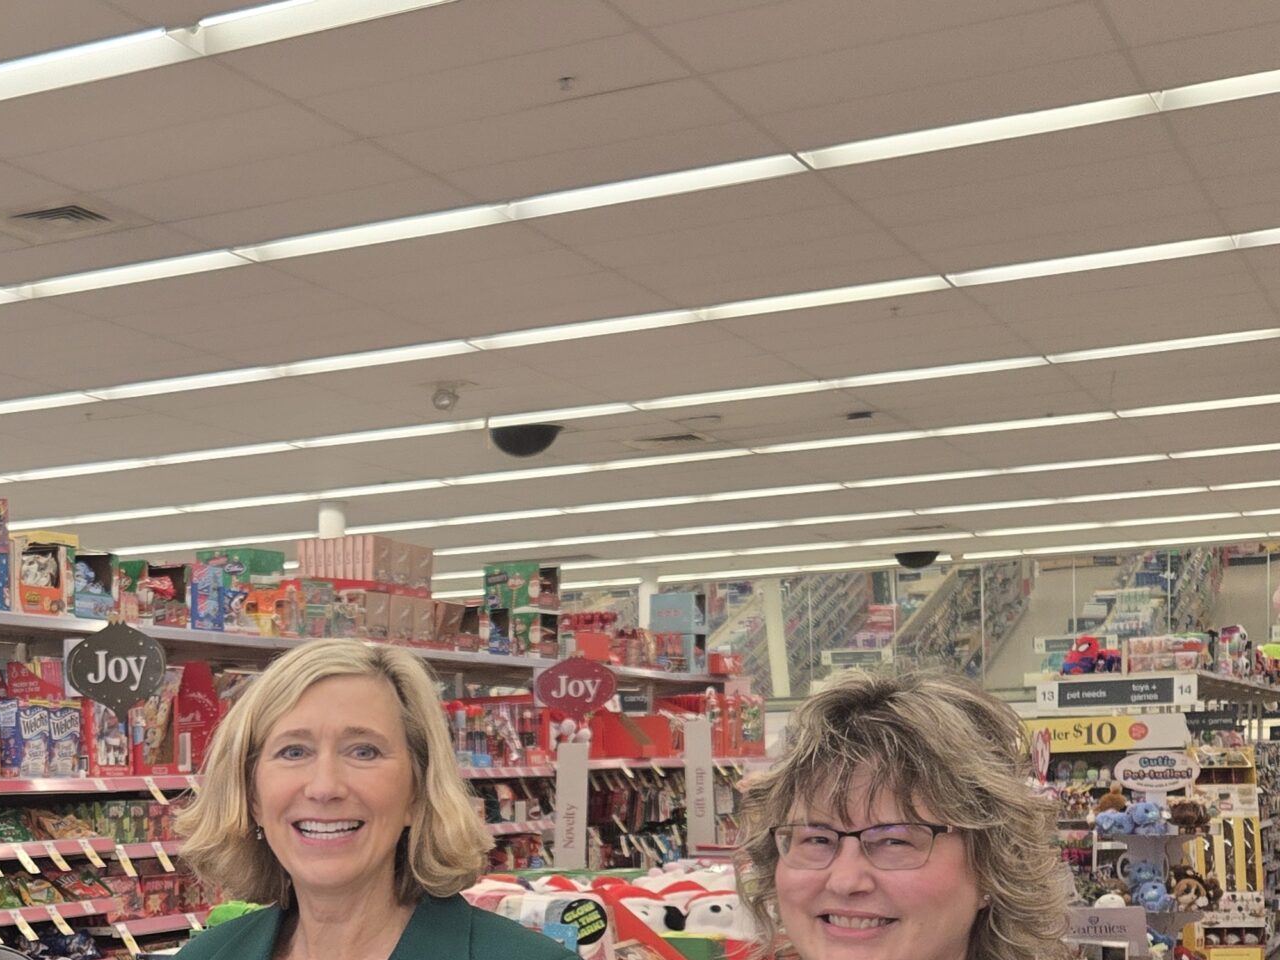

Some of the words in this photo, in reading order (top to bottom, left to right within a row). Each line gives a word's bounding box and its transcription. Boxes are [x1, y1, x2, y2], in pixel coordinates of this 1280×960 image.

[87, 650, 147, 691] Joy
[551, 675, 602, 703] Joy
[1042, 691, 1055, 701] 13
[1066, 690, 1080, 700] pet
[1082, 689, 1107, 698] needs
[1132, 683, 1150, 692] toys
[1178, 684, 1192, 696] 14
[1130, 693, 1158, 702] games
[1073, 721, 1117, 746] $10
[1139, 756, 1177, 768] Cutie
[695, 767, 707, 790] wrap
[695, 792, 706, 818] Gift
[563, 803, 578, 849] Novelty
